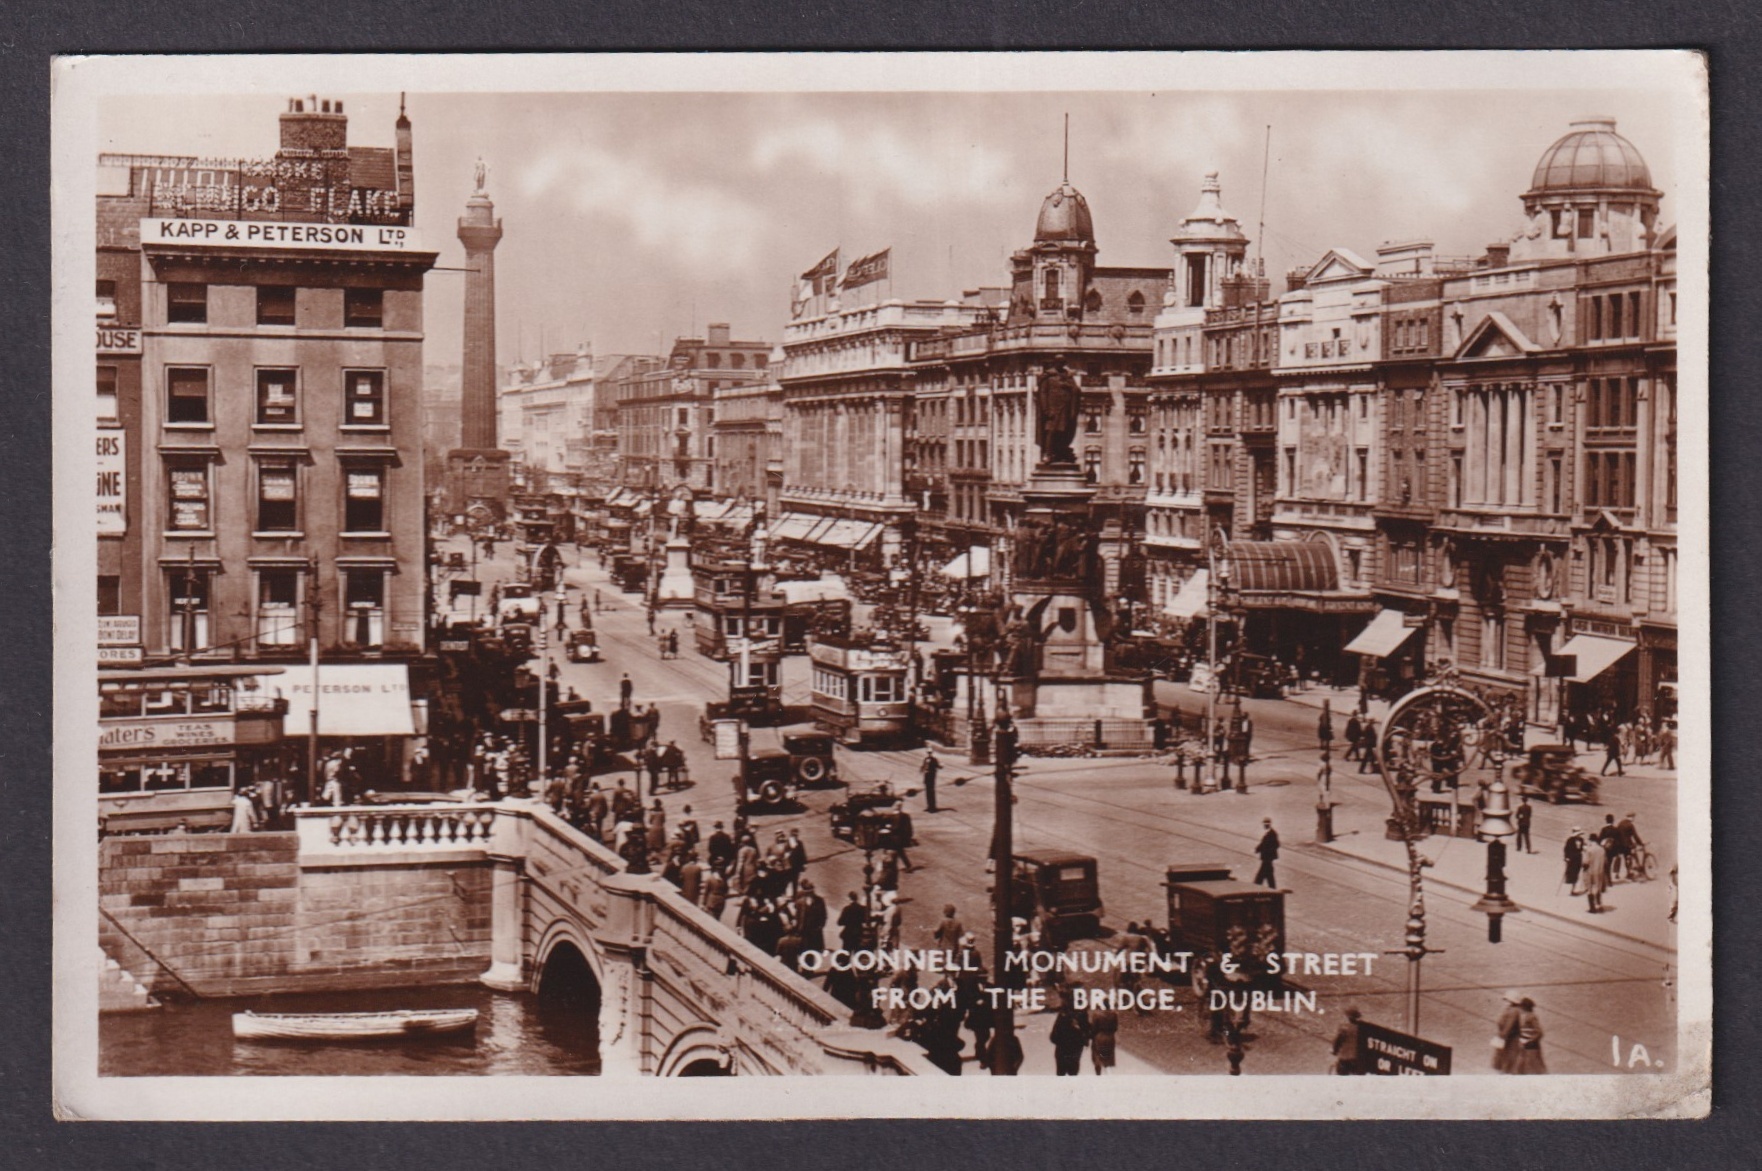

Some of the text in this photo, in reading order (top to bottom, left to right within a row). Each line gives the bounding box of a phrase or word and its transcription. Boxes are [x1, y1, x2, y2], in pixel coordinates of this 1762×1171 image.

[310, 186, 400, 219] FLAKE
[161, 221, 219, 239] KAPP
[225, 224, 240, 240] &
[247, 225, 364, 244] PETERSON
[100, 650, 136, 660] ORES
[1367, 1037, 1438, 1069] STRAIGHT ON
[1377, 1058, 1391, 1072] OR
